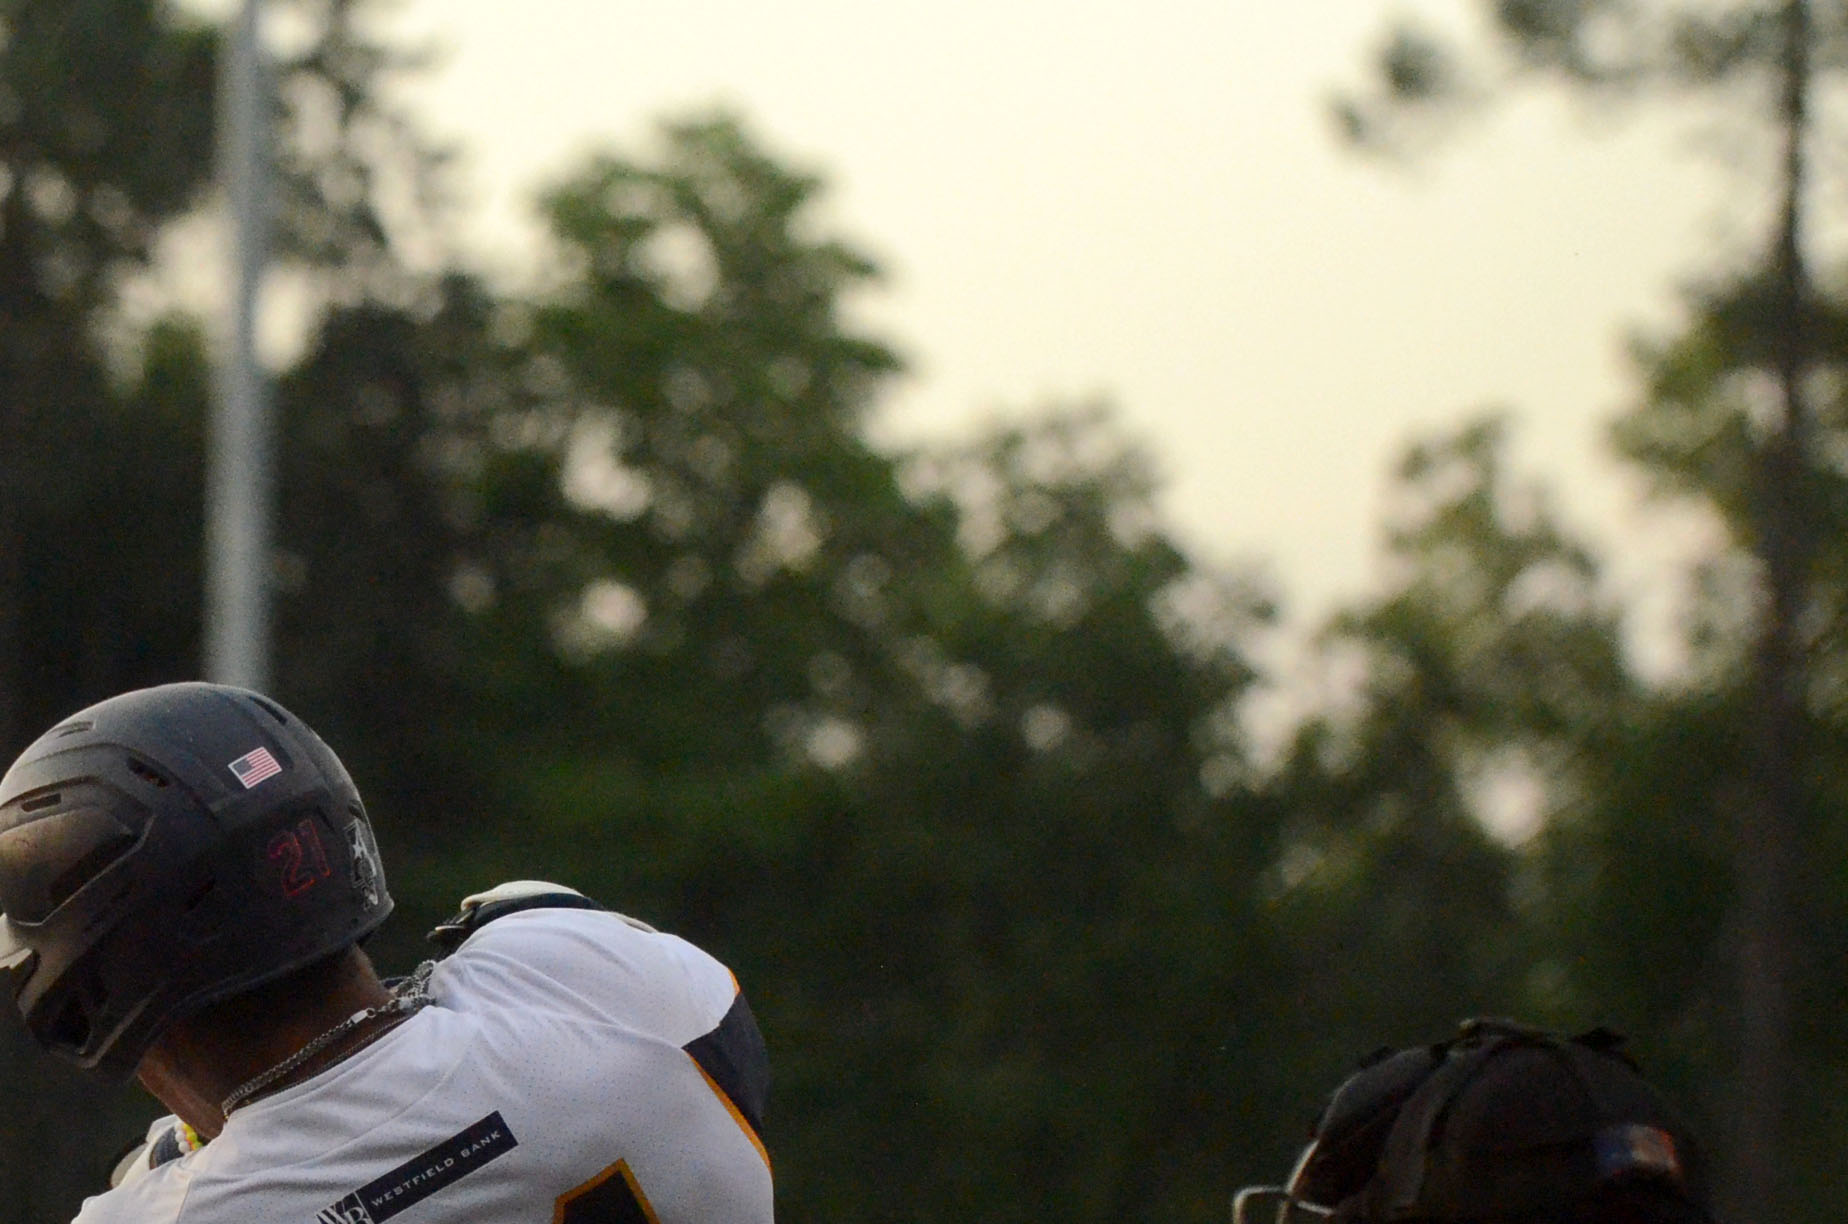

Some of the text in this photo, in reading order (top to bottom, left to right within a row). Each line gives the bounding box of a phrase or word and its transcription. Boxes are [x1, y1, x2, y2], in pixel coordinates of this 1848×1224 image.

[268, 818, 331, 897] 21
[371, 1130, 502, 1208] WESTFIELD BANK
